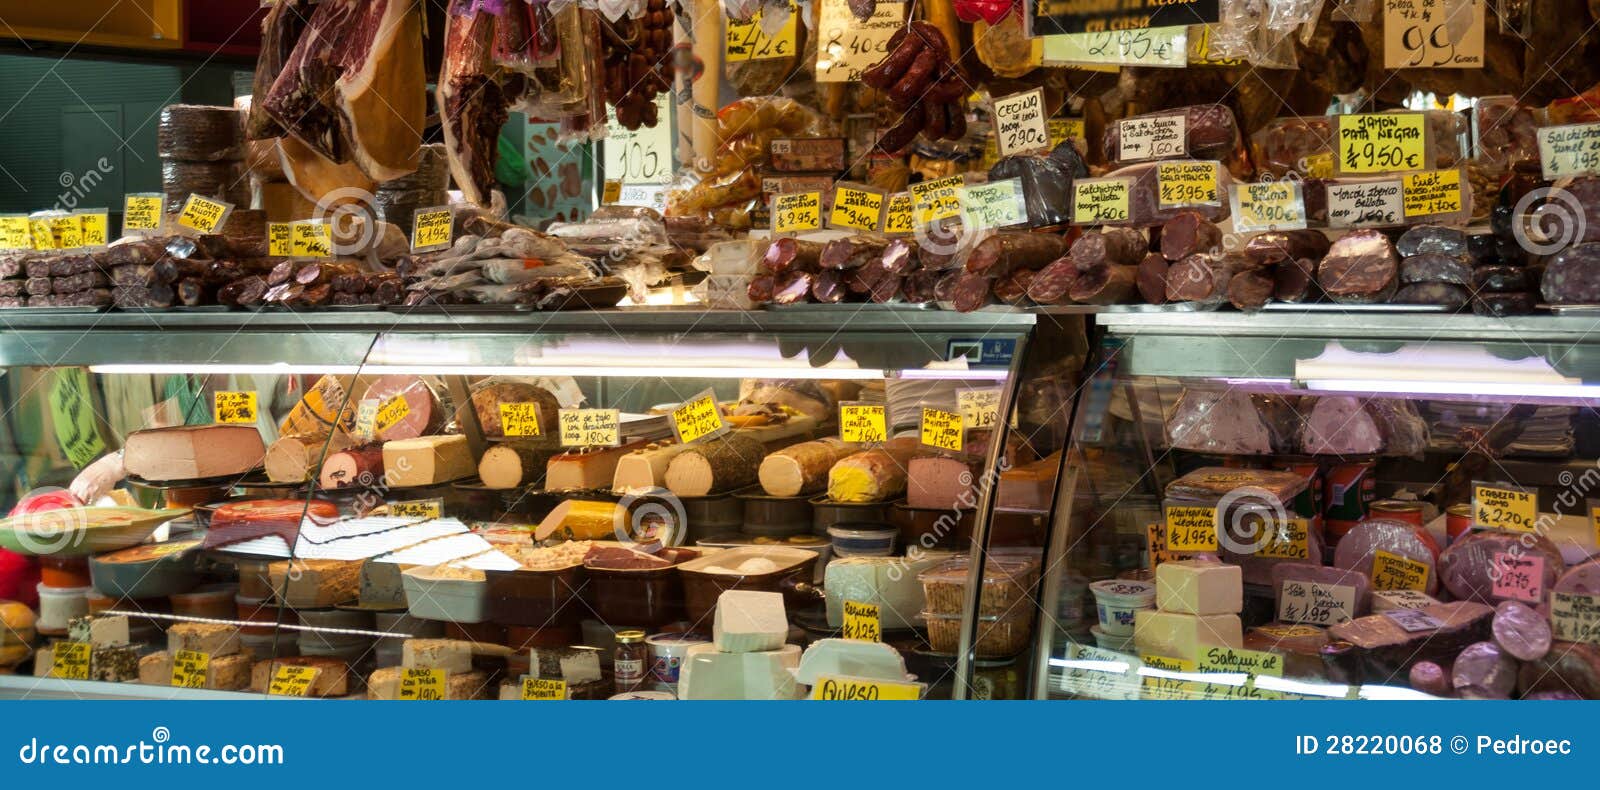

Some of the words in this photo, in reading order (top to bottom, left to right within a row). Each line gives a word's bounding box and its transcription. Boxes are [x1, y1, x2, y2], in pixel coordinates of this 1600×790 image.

[997, 95, 1038, 117] CECINA
[1342, 127, 1369, 139] PATA
[1377, 127, 1421, 140] NEGRA
[1207, 647, 1259, 668] Salami
[1262, 655, 1277, 669] al
